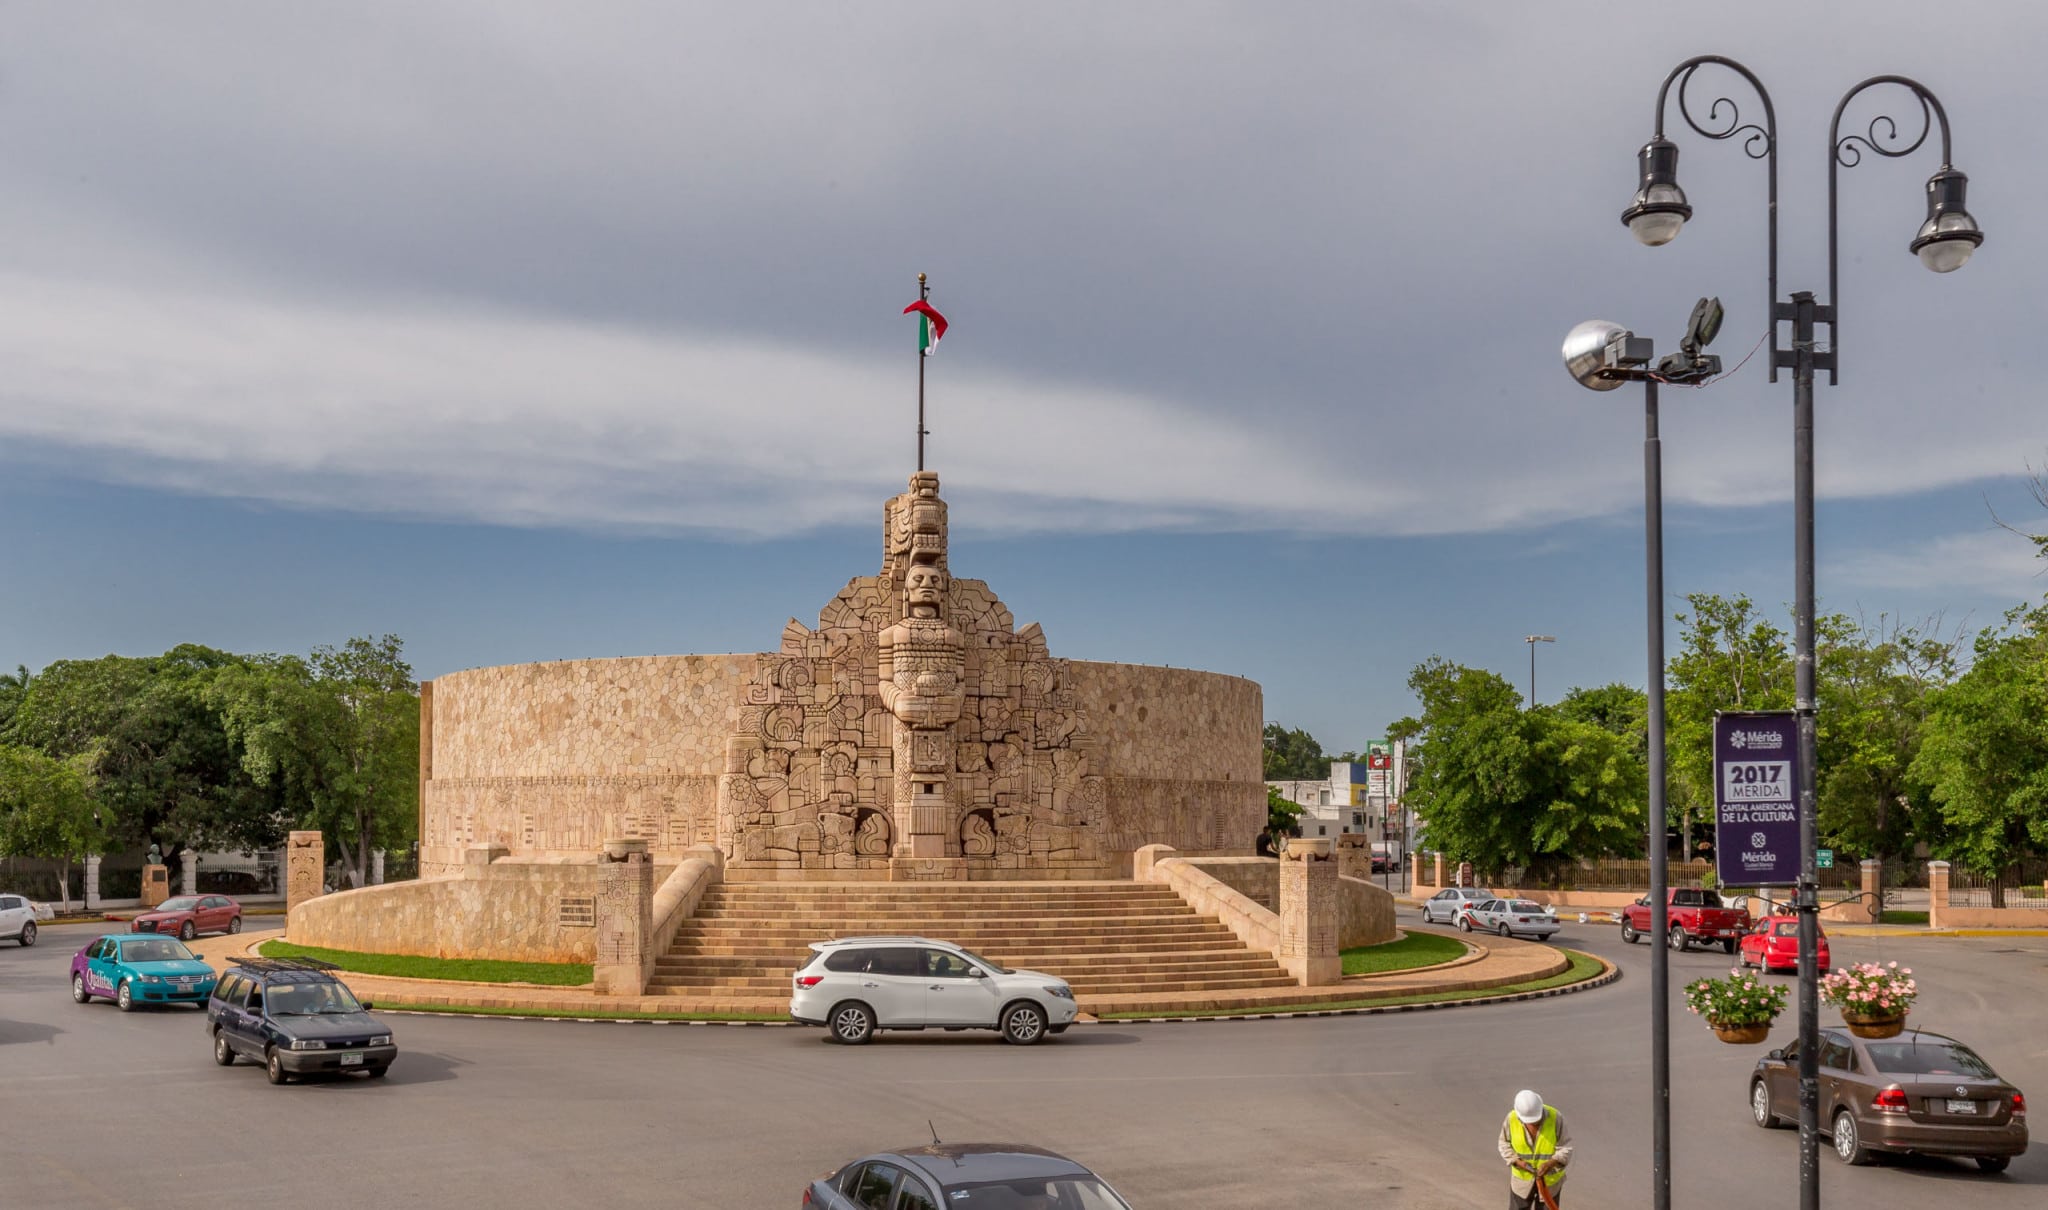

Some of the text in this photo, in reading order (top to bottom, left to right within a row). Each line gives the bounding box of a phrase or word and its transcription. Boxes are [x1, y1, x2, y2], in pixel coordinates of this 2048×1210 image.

[1747, 731, 1783, 742] Mérida
[1731, 765, 1783, 784] 2017
[1732, 785, 1782, 798] MERIDA
[1721, 802, 1795, 812] CAPITAL AMERICANA
[1722, 811, 1796, 823] DE LA CULTURA
[1741, 851, 1777, 863] Mérida
